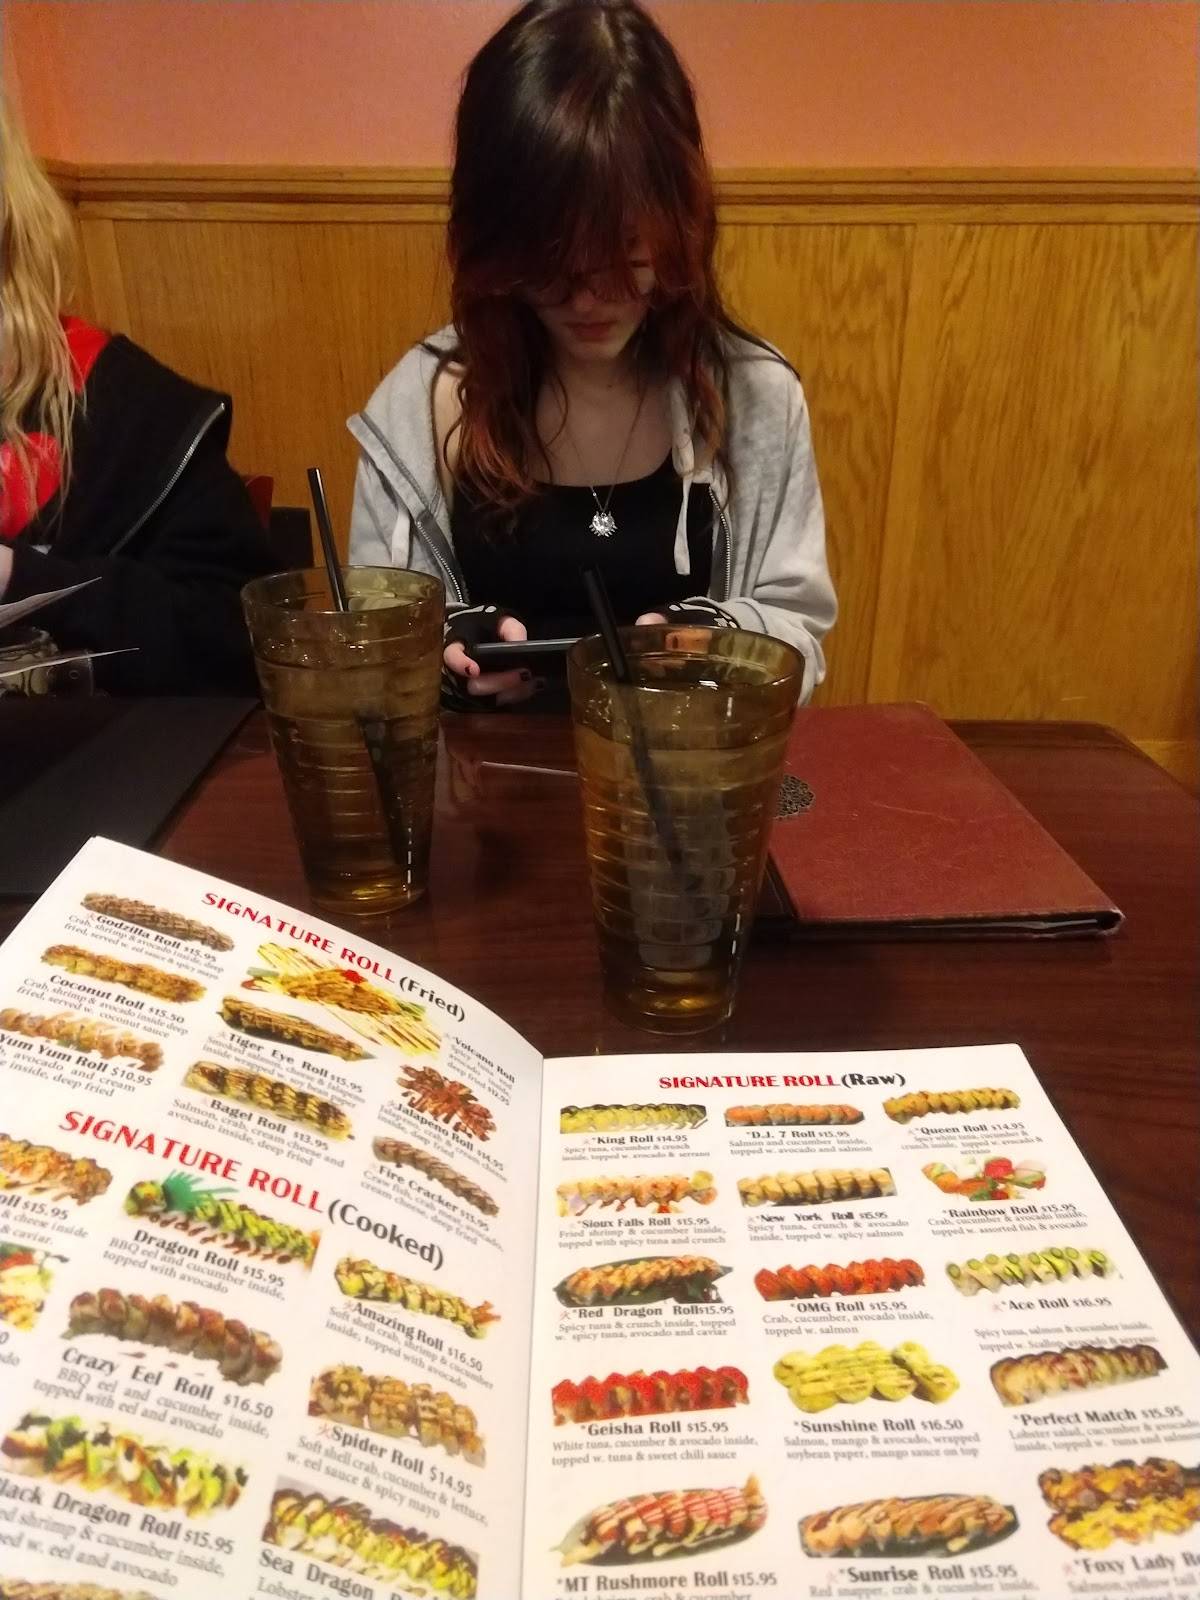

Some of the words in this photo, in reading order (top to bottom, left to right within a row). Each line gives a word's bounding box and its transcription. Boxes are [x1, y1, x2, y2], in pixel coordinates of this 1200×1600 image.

[97, 915, 150, 939] Godzilla
[154, 934, 181, 950] Roll
[184, 946, 216, 962] $15.95
[202, 892, 334, 954] SIGNATURE
[340, 947, 394, 983] ROLL
[399, 976, 465, 1022] (Fried)
[49, 974, 112, 1000] Coconut
[114, 994, 145, 1011] Roll
[149, 1007, 185, 1024] $15.50
[0, 1033, 34, 1051] Yum
[38, 1044, 72, 1062] Yum
[75, 1055, 109, 1073] Roll
[111, 1067, 153, 1086] $10.95
[229, 1032, 265, 1052] Tiger
[271, 1048, 295, 1066] Eye
[301, 1060, 329, 1078] Roll
[330, 1074, 363, 1094] $15.95
[496, 1065, 515, 1084] Roll
[658, 1075, 779, 1089] SIGNATURE
[782, 1074, 840, 1087] ROLL
[841, 1073, 906, 1089] (Raw)
[210, 1098, 254, 1122] Bagel
[256, 1115, 288, 1134] Roll
[293, 1131, 329, 1151] $13.95
[396, 1103, 449, 1137] Jalapeno
[451, 1127, 474, 1152] Roll
[778, 1130, 787, 1138] 7
[790, 1130, 816, 1138] Roll
[818, 1130, 850, 1138] $15.95
[962, 1124, 989, 1133] Roll
[990, 1122, 1025, 1131] $14.95
[629, 1134, 654, 1144] Roll
[656, 1134, 688, 1142] $14.95
[58, 1110, 241, 1182] SIGNATURE
[247, 1167, 322, 1214] ROLL
[327, 1199, 444, 1271] (Cooked)
[378, 1164, 405, 1184] Fire
[408, 1180, 459, 1213] Cracker
[0, 1194, 22, 1208] oll
[22, 1200, 69, 1221] $15.95
[794, 1212, 823, 1222] York
[831, 1211, 855, 1221] Roll
[1010, 1204, 1038, 1215] Roll
[1041, 1203, 1077, 1214] $15.95
[617, 1218, 645, 1228] Falls
[648, 1217, 672, 1227] Roll
[676, 1217, 710, 1226] $15.95
[133, 1229, 200, 1260] Dragon
[204, 1250, 240, 1272] Roll
[243, 1265, 284, 1288] $15.95
[102, 1250, 149, 1270] topped
[149, 1264, 177, 1279] with
[178, 1272, 229, 1294] avocado
[613, 1306, 663, 1319] Dragon
[835, 1300, 865, 1312] Roll
[869, 1301, 907, 1311] $15.95
[1037, 1297, 1070, 1309] Roll
[1072, 1297, 1112, 1307] $16.95
[554, 1334, 567, 1342] w.
[572, 1332, 599, 1343] spicy
[600, 1331, 628, 1339] tuna,
[629, 1328, 673, 1338] avocado
[674, 1328, 695, 1337] and
[696, 1328, 728, 1337] caviar
[559, 1323, 586, 1334] Spicy
[614, 1321, 624, 1329] &
[625, 1320, 662, 1329] crunch
[664, 1319, 699, 1328] inside,
[698, 1318, 737, 1332] topped
[764, 1325, 803, 1338] topped
[804, 1327, 817, 1335] w.
[818, 1325, 860, 1335] salmon
[353, 1302, 415, 1342] Amazing
[416, 1328, 444, 1352] Roll
[448, 1347, 483, 1372] $16.50
[61, 1347, 119, 1377] Crazy
[130, 1364, 164, 1386] Eel
[173, 1376, 215, 1401] Roll
[223, 1394, 274, 1419] $16.50
[1084, 1408, 1138, 1423] Match
[1141, 1405, 1184, 1419] $15.95
[649, 1421, 682, 1434] Roll
[687, 1421, 729, 1433] $15.95
[882, 1418, 916, 1432] Roll
[920, 1419, 964, 1431] $16.50
[552, 1440, 584, 1452] White
[585, 1441, 613, 1450] tuna,
[614, 1438, 666, 1448] cucumber
[667, 1437, 678, 1447] &
[679, 1436, 722, 1446] avocado
[723, 1436, 759, 1446] inside,
[331, 1425, 388, 1459] Spider
[390, 1448, 424, 1476] Roll
[429, 1466, 472, 1498] $14.95
[551, 1454, 590, 1469] topped
[592, 1455, 605, 1463] w.
[607, 1453, 634, 1463] tuna
[635, 1452, 645, 1462] &
[647, 1451, 678, 1462] sweet
[679, 1450, 705, 1461] chili
[706, 1451, 737, 1460] sauce
[0, 1477, 42, 1505] lack
[52, 1491, 132, 1528] Dragon
[139, 1513, 183, 1541] Roll
[183, 1529, 234, 1555] $15.95
[927, 1564, 965, 1580] Roll
[969, 1564, 1018, 1578] $15.95
[1130, 1554, 1176, 1572] Lady
[259, 1550, 295, 1576] Sea
[305, 1564, 378, 1600] Dragon
[596, 1573, 688, 1592] Rushmore
[693, 1570, 729, 1588] Roll
[732, 1571, 777, 1587] $15.95
